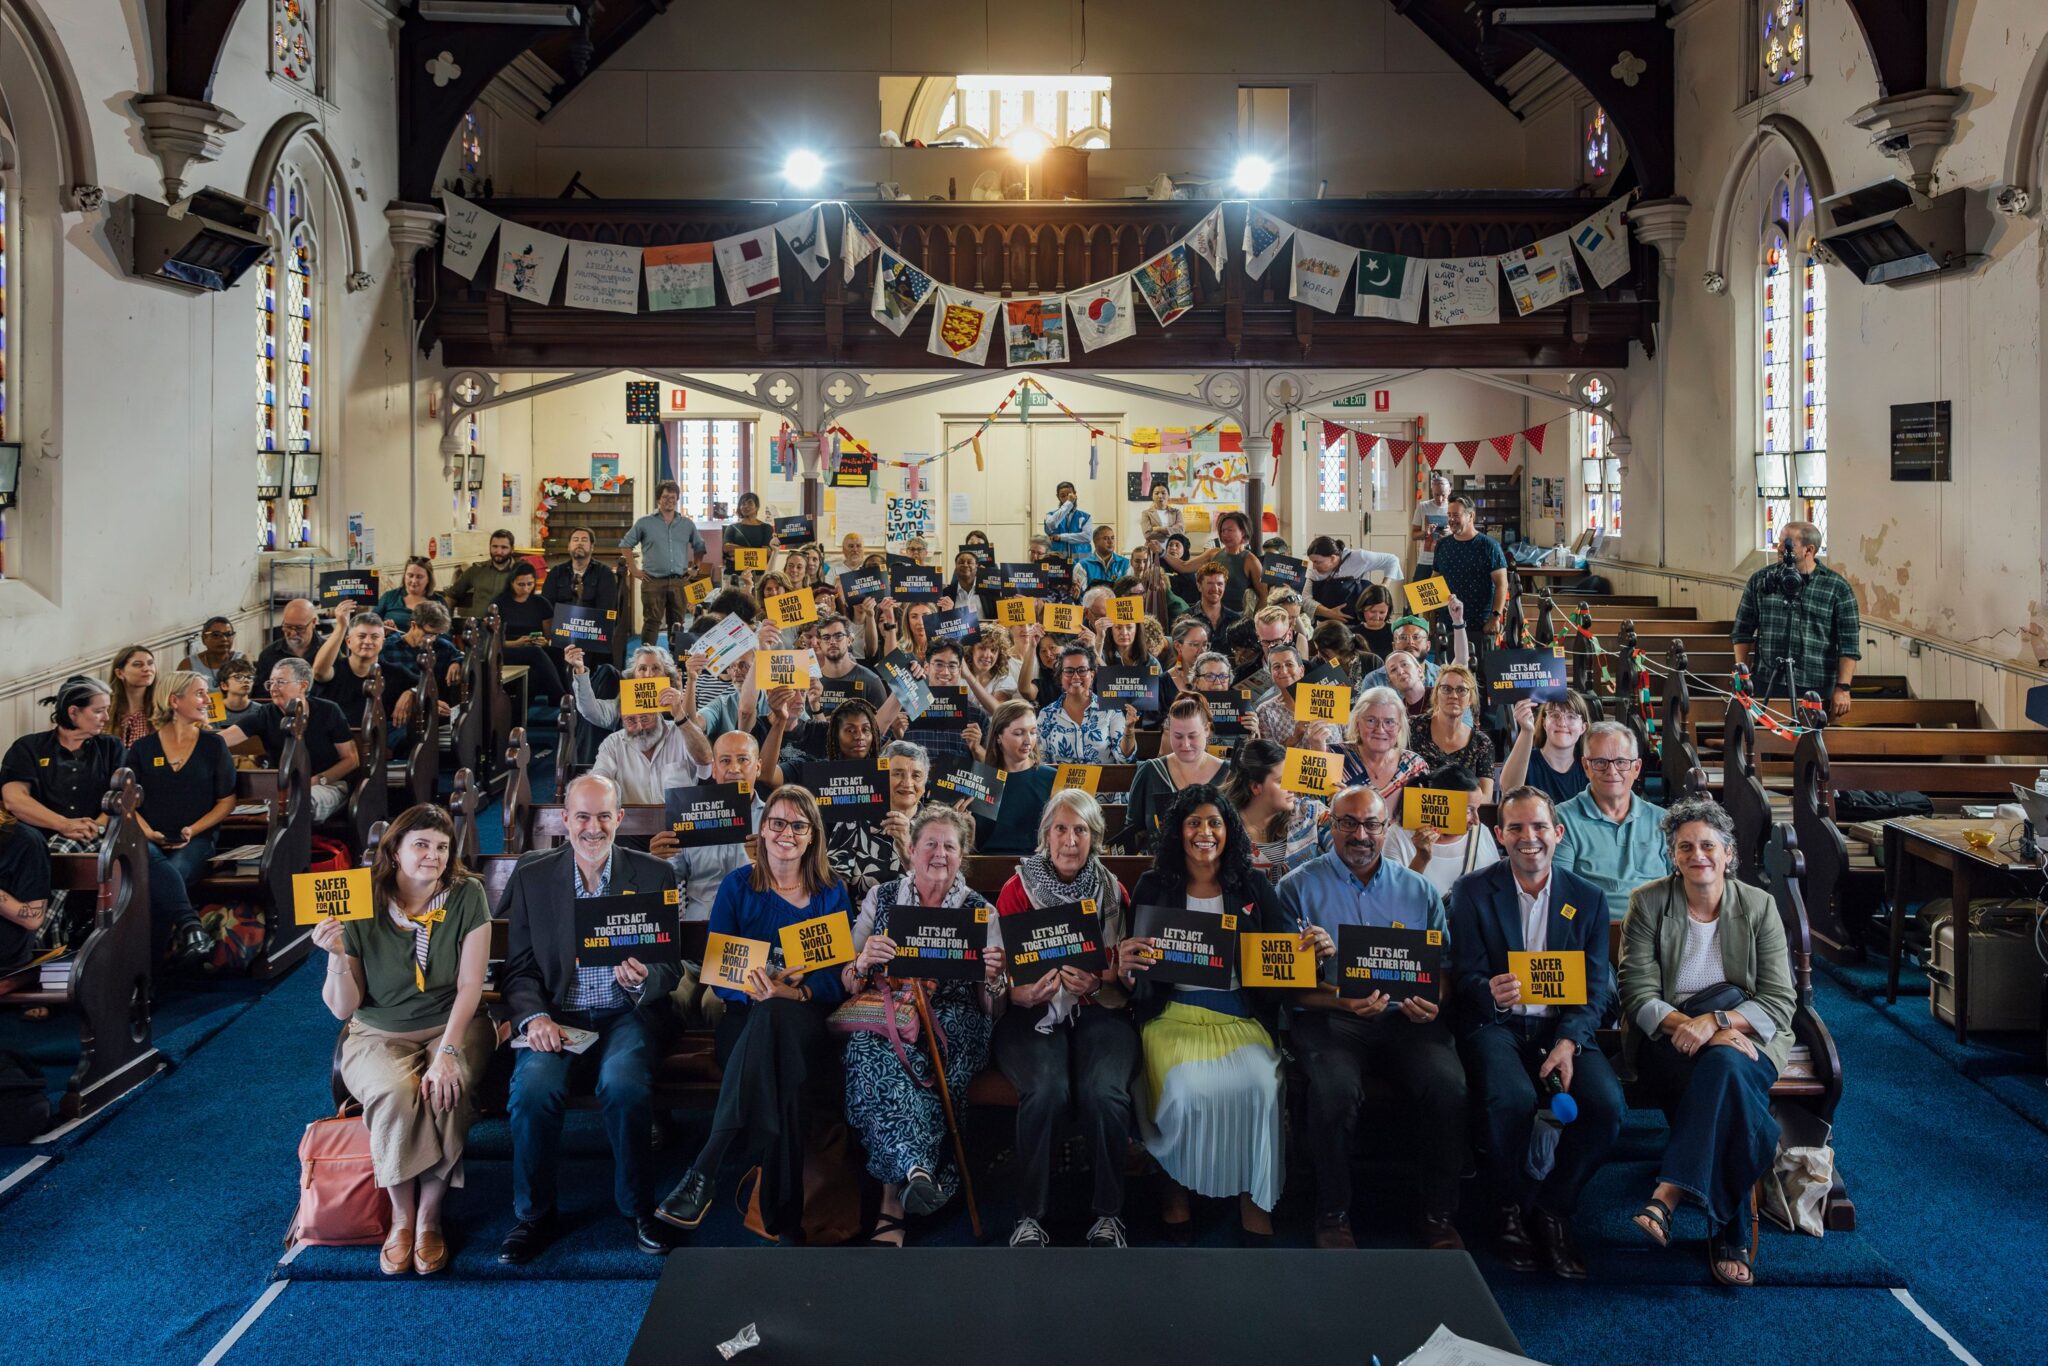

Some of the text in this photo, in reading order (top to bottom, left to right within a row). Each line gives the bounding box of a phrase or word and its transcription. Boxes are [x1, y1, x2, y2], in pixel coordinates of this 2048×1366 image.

[1302, 280, 1333, 296] KOREA
[1350, 395, 1364, 405] EXIT
[888, 498, 928, 510] JESUS
[906, 509, 931, 520] OUR
[886, 530, 925, 542] WATER
[779, 596, 799, 607] SAFER
[780, 603, 802, 614] WORLD
[790, 611, 804, 622] ALL
[771, 656, 793, 664] SAFER
[779, 673, 795, 684] ALL
[1501, 672, 1534, 680] TOGETHER
[635, 682, 655, 691] SAFER
[635, 691, 657, 699] WORLD
[1311, 689, 1334, 699] SAFER
[643, 698, 658, 708] ALL
[1311, 698, 1334, 707] WORLD
[1318, 707, 1334, 718] ALL
[1302, 756, 1327, 768] SAFER
[957, 769, 984, 783] LET'S ACT
[1301, 766, 1327, 777] WORLD
[830, 777, 863, 786] LET'S ACT
[948, 774, 975, 789] TOGETHER
[975, 783, 986, 792] FOR
[1307, 776, 1324, 790] ALL
[819, 786, 855, 796] TOGETHER
[856, 786, 869, 794] FOR
[938, 779, 994, 803] SAFER WORLD FOR ALL
[692, 800, 724, 811] LET'S ACT
[815, 797, 832, 805] AFER
[833, 796, 856, 804] WORLD
[857, 795, 870, 803] FOR
[1422, 794, 1448, 806] SAFER
[681, 811, 716, 821] TOGETHER
[717, 809, 730, 818] FOR
[1422, 805, 1449, 815] WORLD
[674, 817, 744, 831] SAFER WORLD FOR ALL
[1430, 815, 1449, 828] ALL
[315, 878, 347, 891] SAFER
[316, 889, 350, 902] WORLD
[328, 901, 351, 916] ALL
[607, 913, 646, 925] LET'S ACT
[594, 923, 660, 936] TOGETHER FOR A
[799, 923, 828, 940] SAFER
[919, 926, 957, 937] LET'S ACT
[1032, 924, 1069, 939] LET'S ACT
[1164, 928, 1203, 942] LET'S ACT
[585, 933, 670, 948] SAFER WORLD FOR ALL
[801, 934, 832, 950] WORLD
[906, 936, 968, 949] TOGETHER FOR A
[1022, 932, 1084, 952] TOGETHER FOR A
[1151, 937, 1214, 955] TOGETHER FOR A
[1262, 940, 1292, 952] SAFER
[724, 942, 749, 957] SAFER
[815, 945, 836, 962] ALL
[895, 947, 977, 960] SAFER WORLD FOR ALL
[1015, 941, 1096, 964] SAFER WORLD FOR ALL
[1370, 947, 1409, 959] LET'S ACT
[722, 954, 748, 968] WORLD
[1165, 950, 1192, 963] WORLD
[1193, 954, 1208, 965] FOR
[1210, 957, 1223, 967] ALL
[1262, 953, 1294, 964] WORLD
[1357, 957, 1421, 971] TOGETHER FOR A
[1531, 959, 1562, 971] SAFER
[727, 967, 744, 984] ALL
[1274, 965, 1295, 980] ALL
[1346, 967, 1431, 983] SAFER WORLD FOR ALL
[1531, 971, 1564, 982] WORLD
[1543, 983, 1565, 998] ALL
